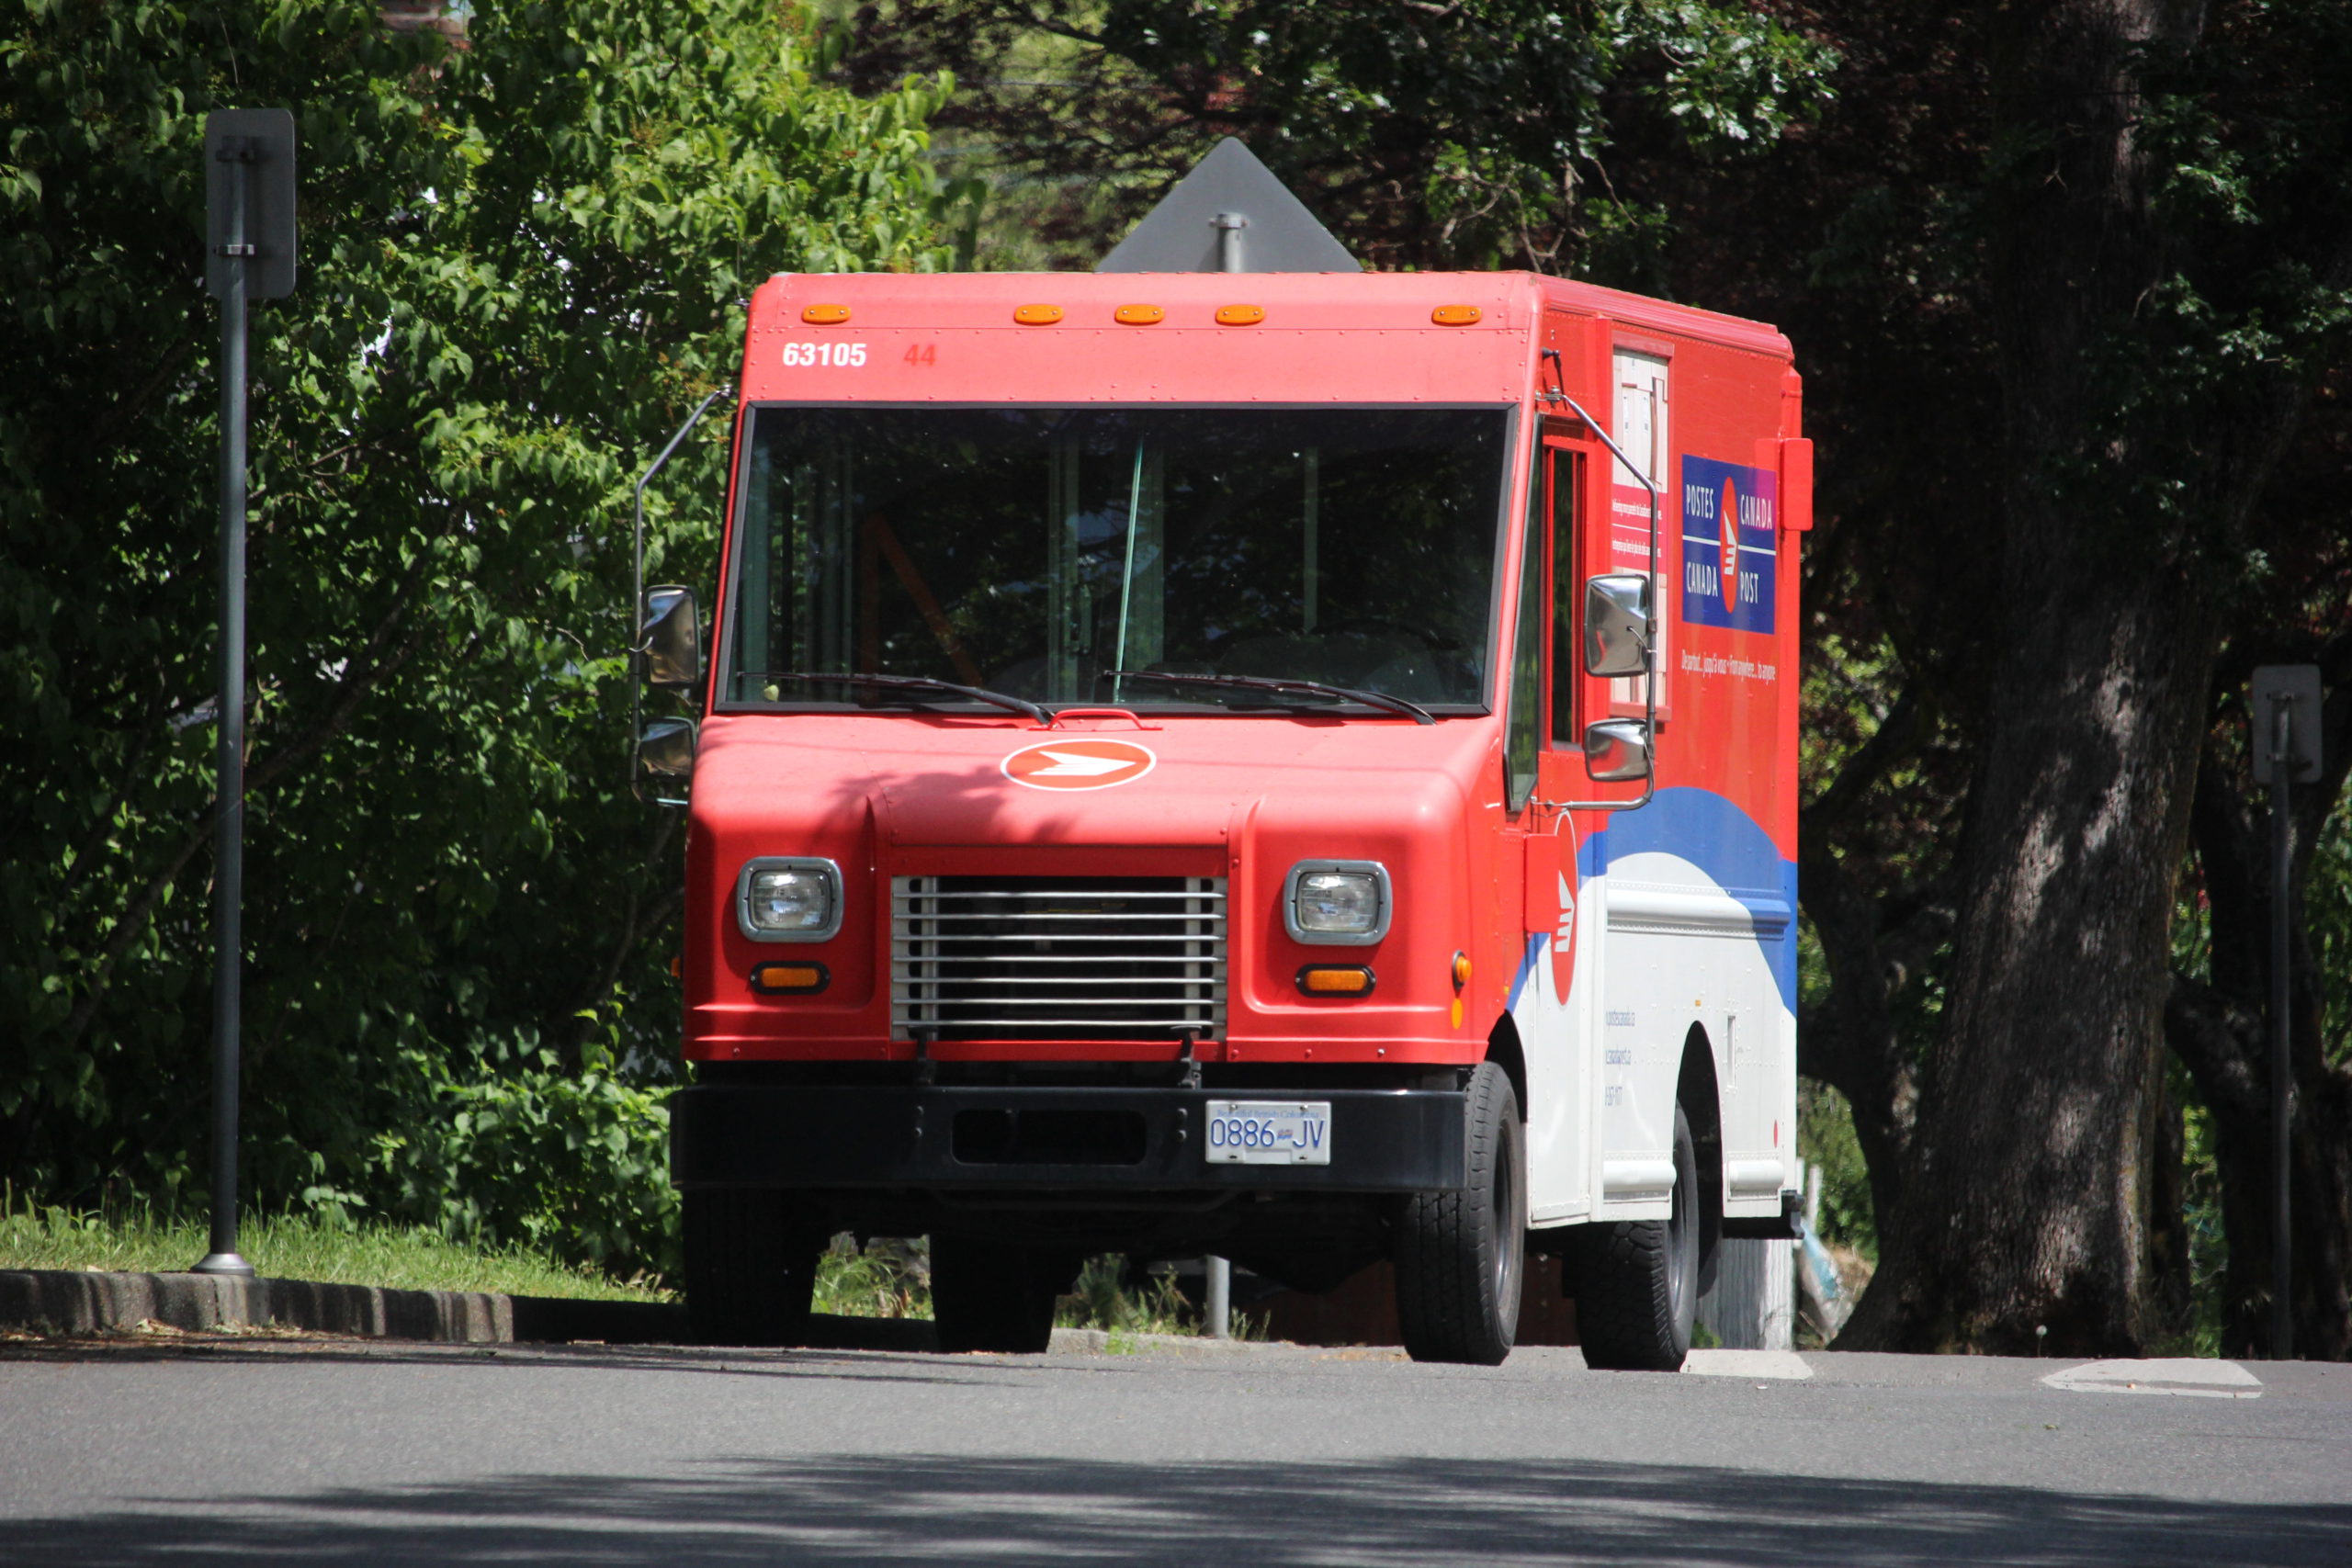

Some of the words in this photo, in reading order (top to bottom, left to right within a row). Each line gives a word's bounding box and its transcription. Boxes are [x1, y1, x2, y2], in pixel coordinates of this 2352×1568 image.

[783, 343, 867, 367] 63105
[903, 344, 936, 367] 44
[1686, 484, 1714, 520] POSTES
[1740, 494, 1772, 529] CANADA
[1686, 561, 1718, 597] CANADA
[1740, 570, 1758, 604] POST
[1211, 1118, 1275, 1147] 0886
[1292, 1120, 1325, 1148] JV
